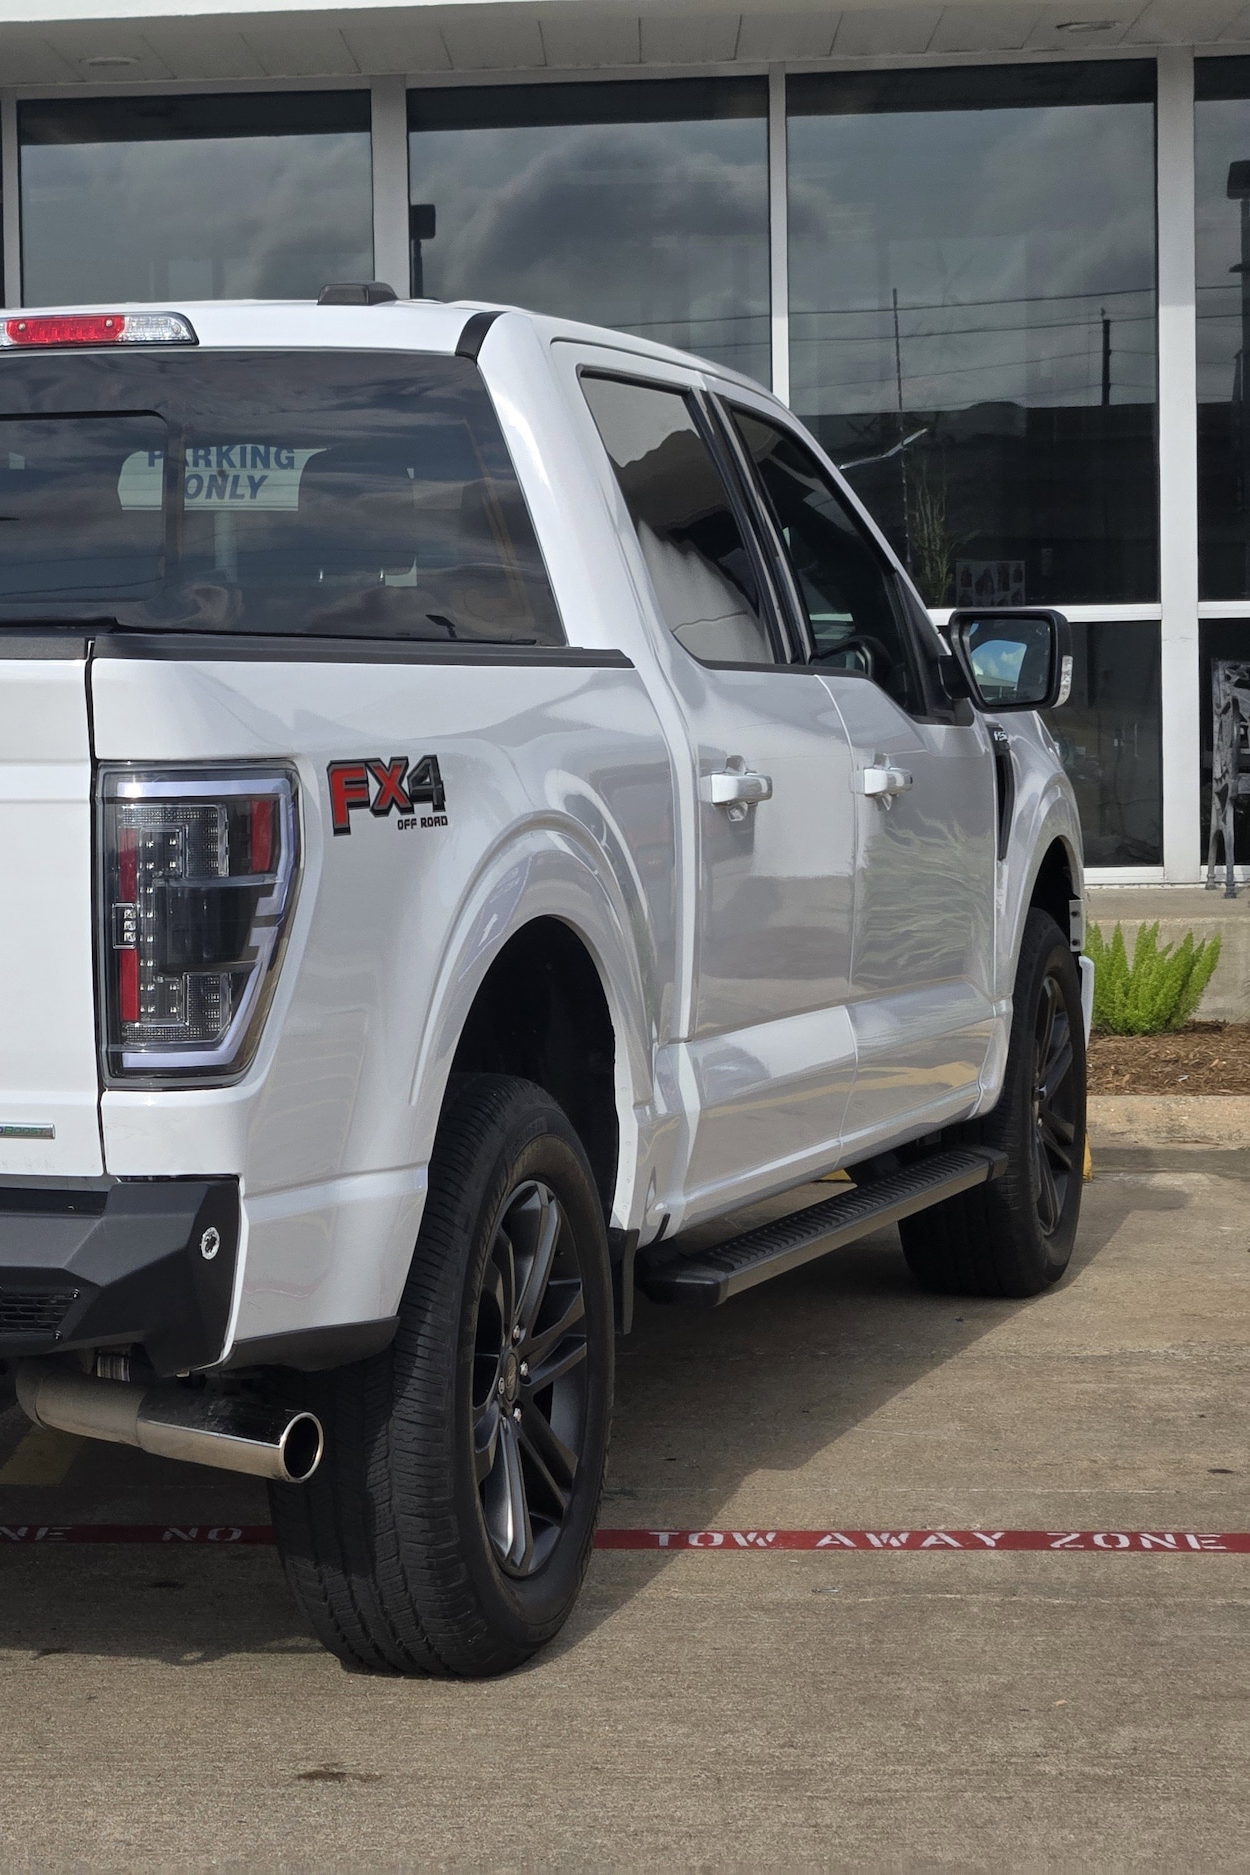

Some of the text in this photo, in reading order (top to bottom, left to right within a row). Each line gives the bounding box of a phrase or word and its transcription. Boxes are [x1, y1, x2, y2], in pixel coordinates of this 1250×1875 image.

[148, 443, 296, 470] PRKING
[183, 473, 269, 500] ONLY
[327, 754, 446, 836] FX4
[397, 815, 448, 831] OFF ROAD
[161, 1526, 243, 1541] NO
[648, 1531, 1228, 1550] TOW AWAY ZONE
